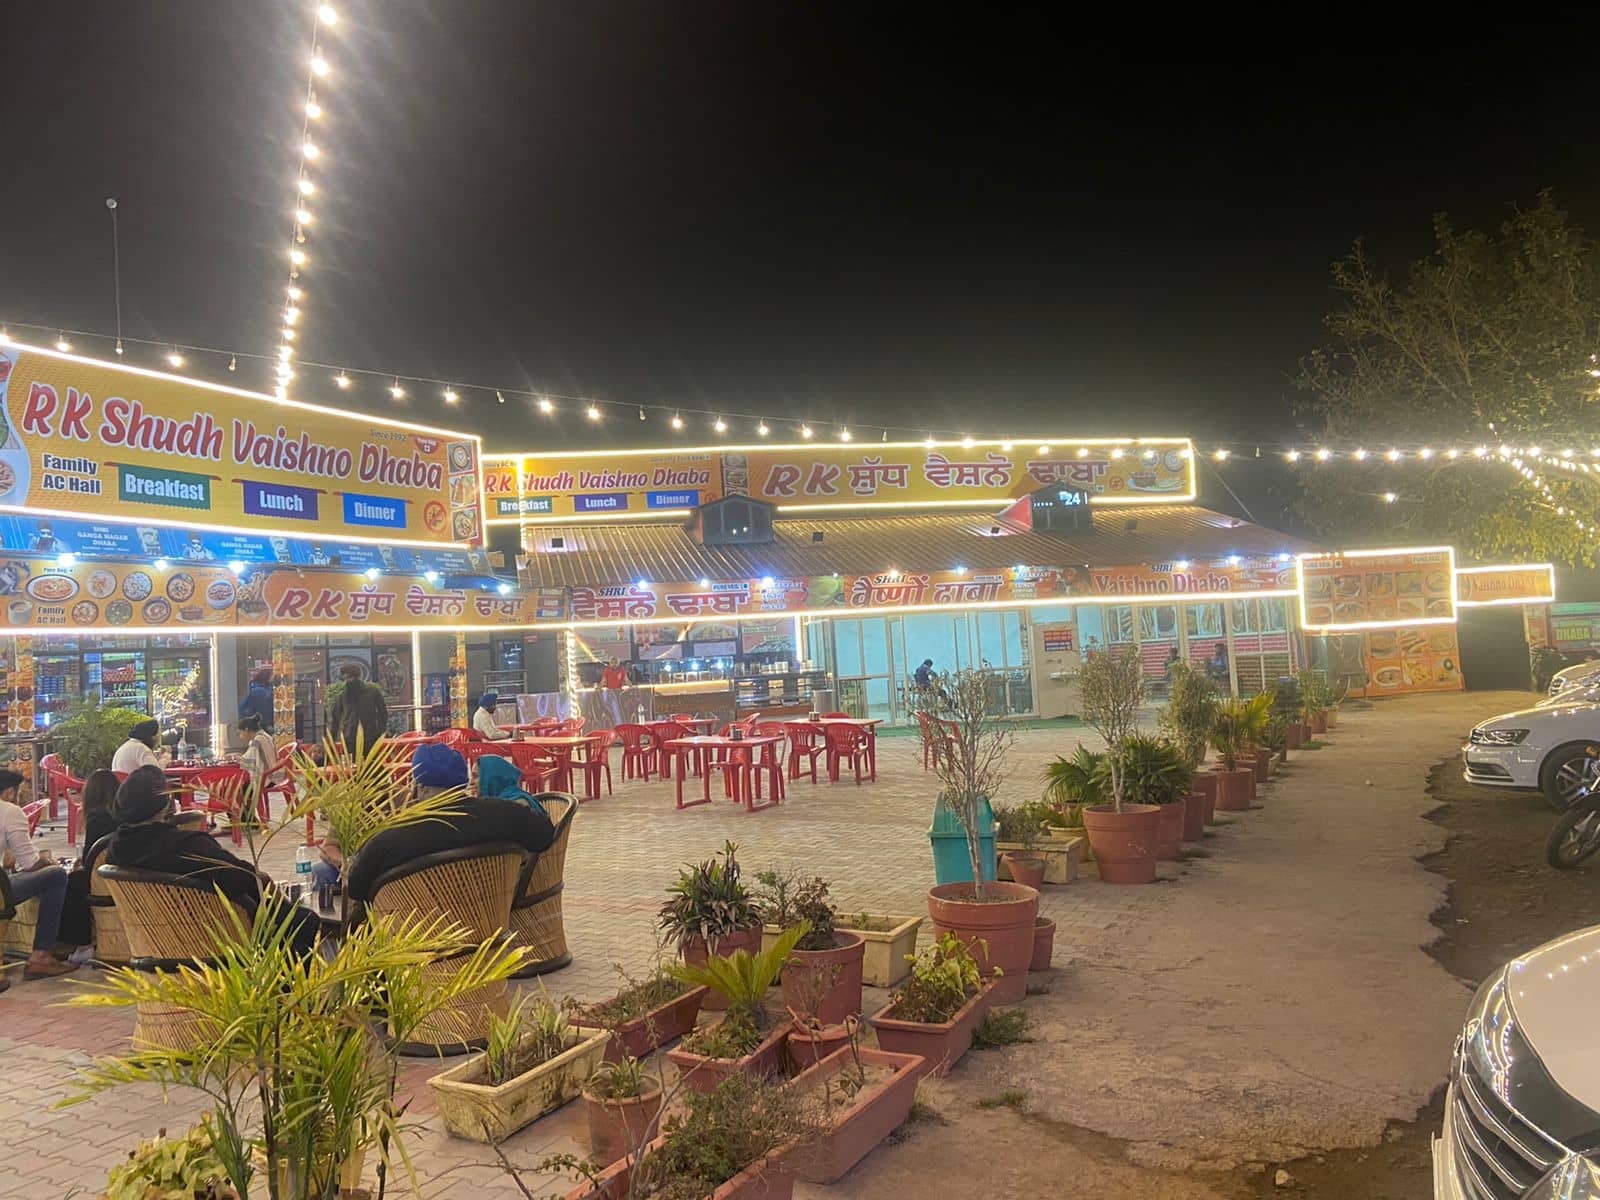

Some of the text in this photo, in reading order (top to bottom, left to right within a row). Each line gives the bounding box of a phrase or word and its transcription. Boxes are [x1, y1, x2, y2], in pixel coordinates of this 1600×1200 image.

[100, 396, 224, 462] Shudh
[231, 418, 352, 478] Vaishno
[359, 441, 443, 490] Dhaba
[43, 453, 97, 476] Family
[923, 452, 1014, 488] ਵੈਸ਼ਨੋ
[1026, 459, 1110, 484] ਢਾਬਾ
[42, 473, 101, 495] AC Hall
[125, 472, 205, 502] Breakfast
[578, 468, 649, 490] Vaishno
[652, 466, 710, 487] Dhaba
[259, 490, 303, 512] Lunch
[500, 500, 549, 512] Brekfast
[585, 497, 617, 508] Lunch
[656, 495, 690, 505] Dinner
[354, 502, 396, 521] Dinner
[1152, 564, 1173, 573] SHRI
[598, 587, 625, 597] SHRI
[1094, 572, 1230, 593] Vaishno Dhaba
[38, 606, 65, 615] Family
[665, 592, 750, 616] ਢਾਬਾ
